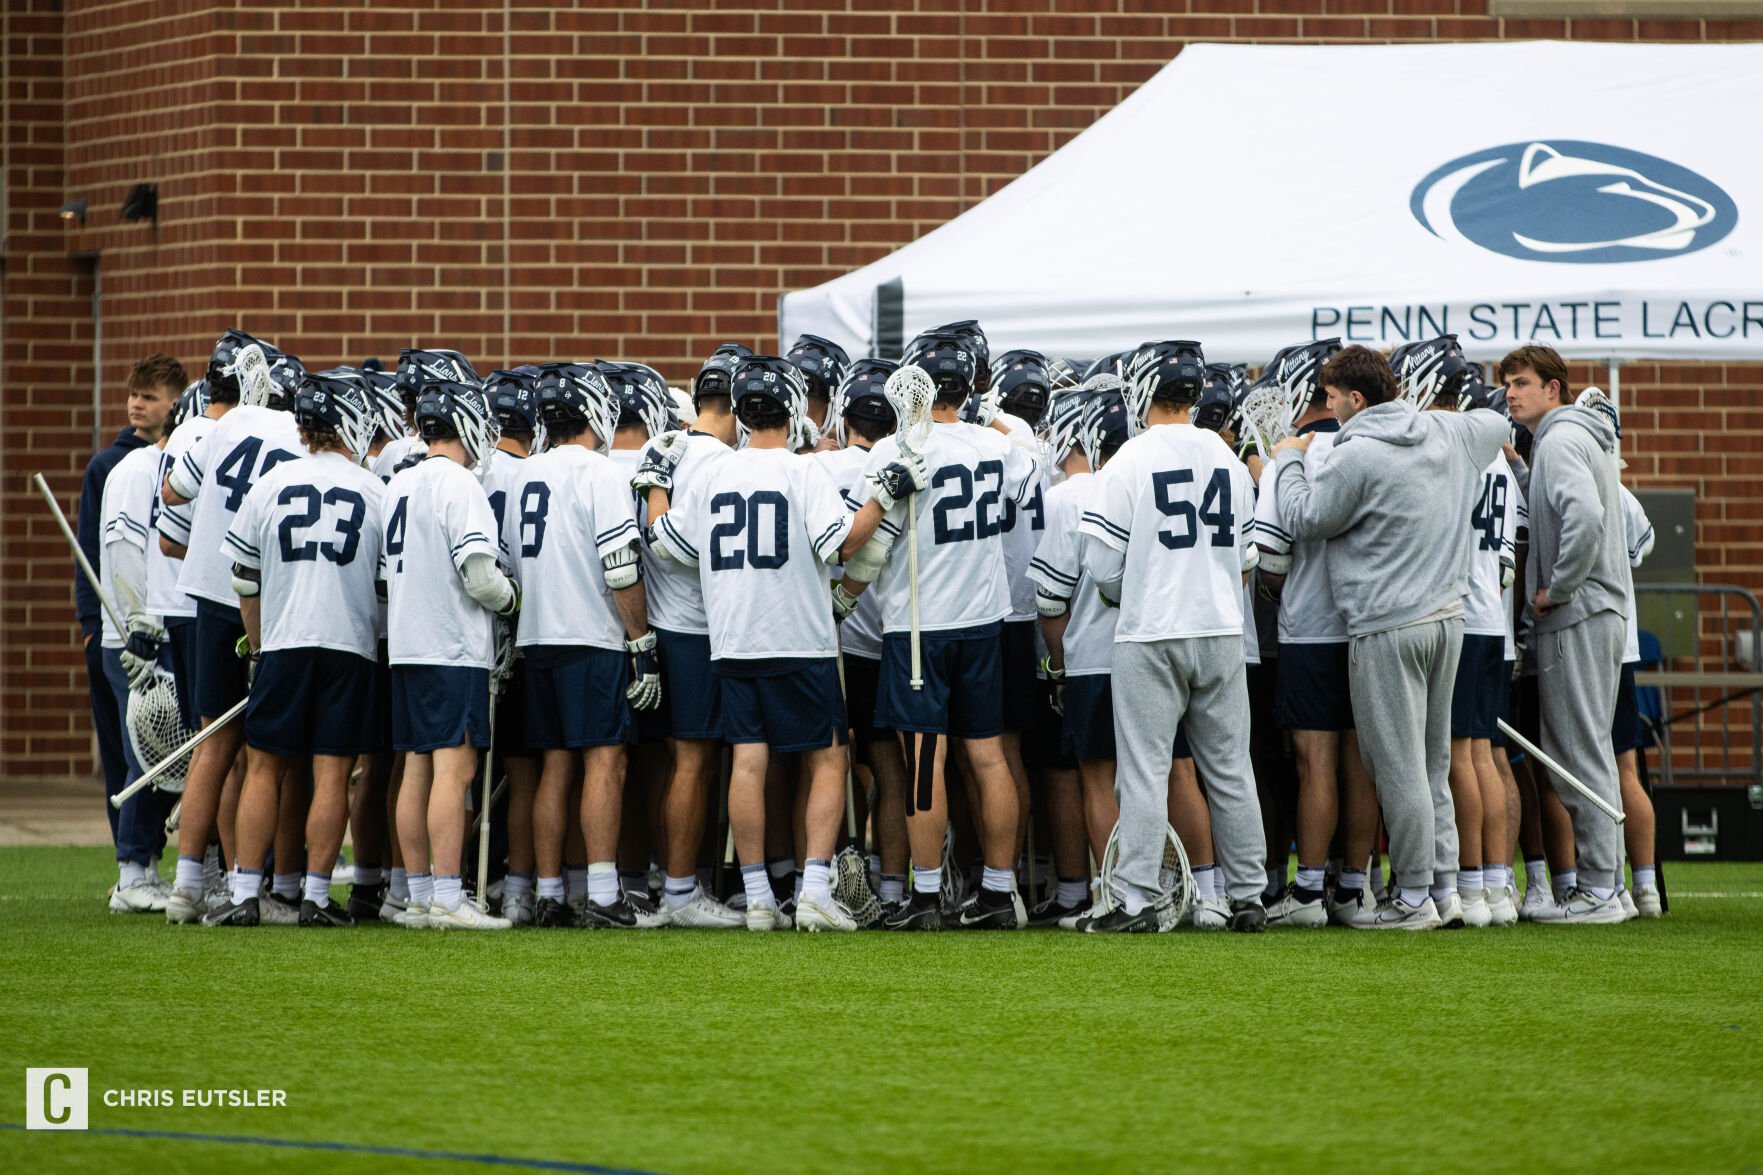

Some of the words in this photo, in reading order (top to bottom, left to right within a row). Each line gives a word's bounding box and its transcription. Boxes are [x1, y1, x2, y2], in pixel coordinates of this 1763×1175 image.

[1312, 304, 1448, 341] PENN
[1468, 301, 1622, 340] STATE
[957, 350, 967, 362] 22
[407, 363, 417, 375] 16
[429, 359, 459, 382] Lions
[763, 371, 777, 383] 20
[559, 378, 566, 388] 8
[581, 370, 606, 394] Lions
[624, 384, 634, 395] 18
[313, 391, 326, 403] 23
[341, 387, 364, 412] Lions
[438, 394, 446, 404] 4
[460, 390, 485, 416] Lions
[517, 389, 528, 400] 12
[931, 459, 1004, 546] 22
[1152, 468, 1235, 550] 54
[1471, 472, 1508, 551] 48
[277, 484, 367, 568] 23
[519, 481, 552, 559] 8
[709, 490, 789, 572] 20
[386, 495, 409, 574] 4
